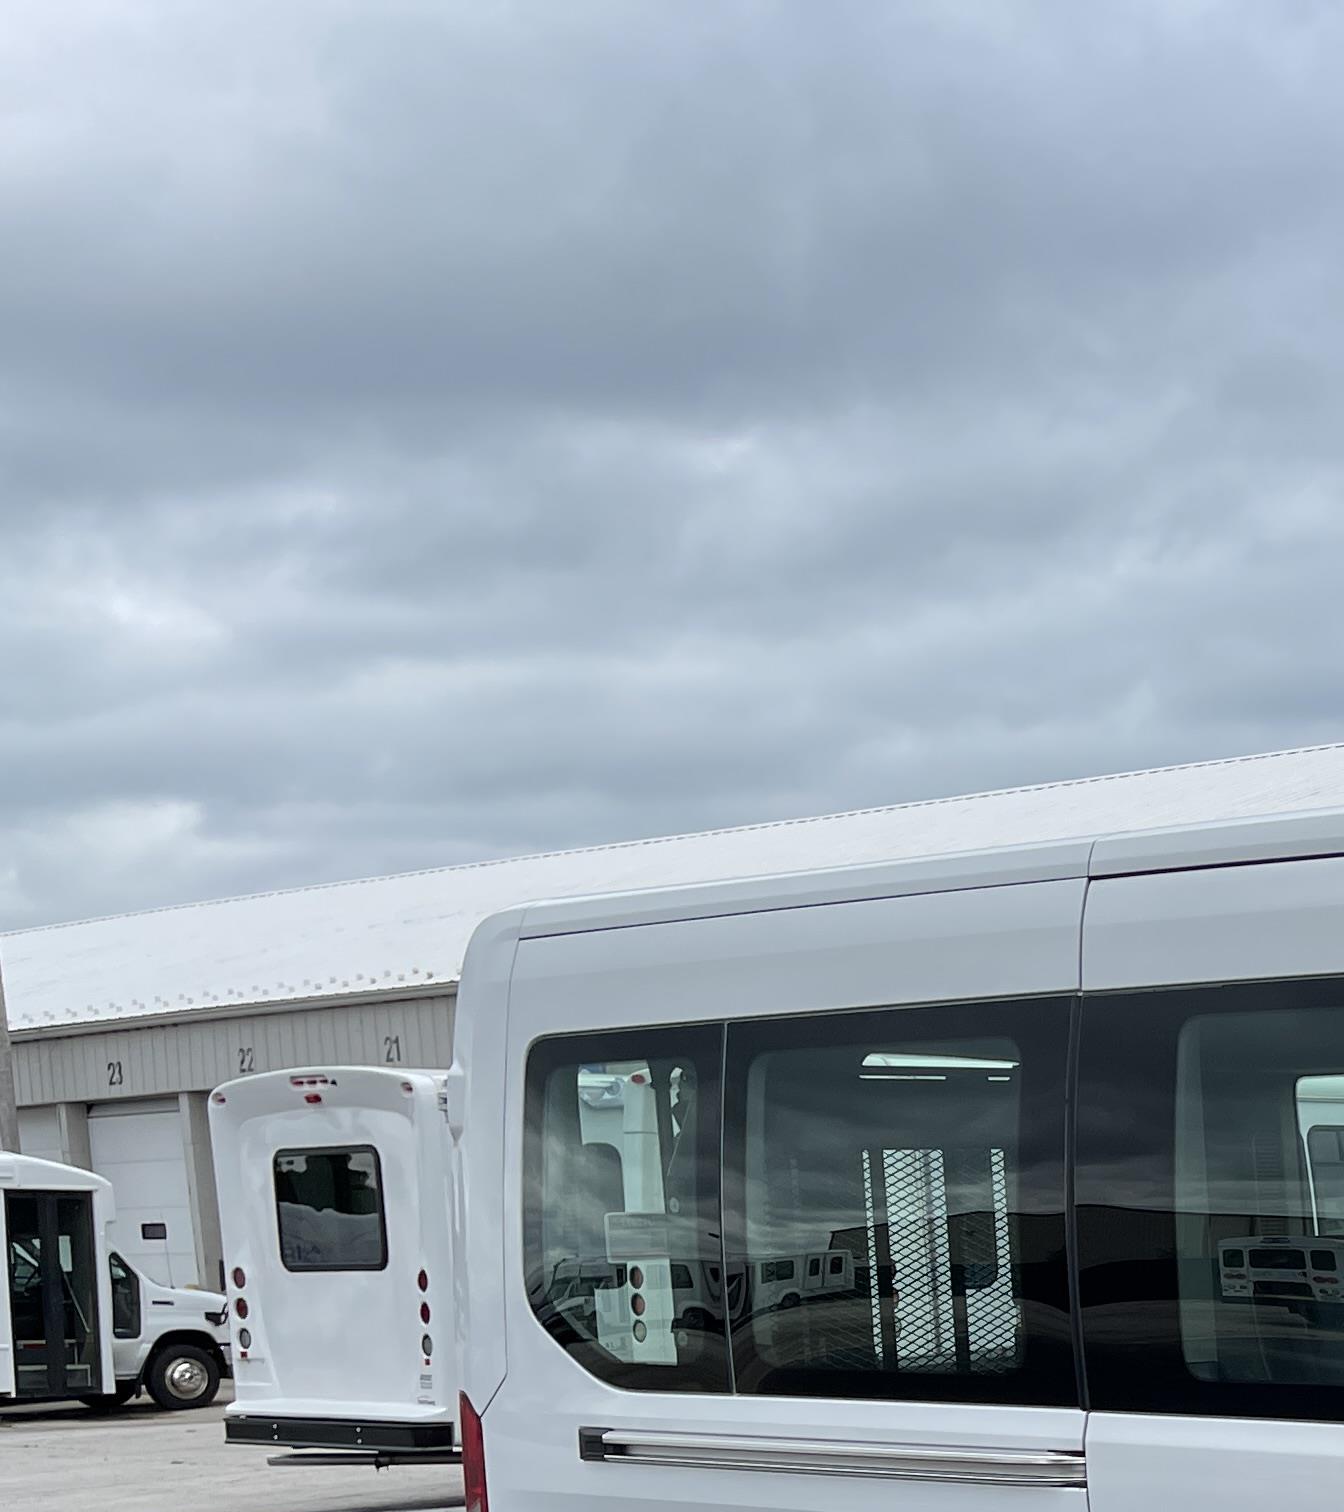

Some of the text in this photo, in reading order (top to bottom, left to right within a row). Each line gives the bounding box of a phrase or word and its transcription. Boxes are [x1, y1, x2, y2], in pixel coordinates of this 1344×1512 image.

[238, 1047, 254, 1073] 22
[384, 1036, 401, 1062] 21
[107, 1061, 123, 1085] 23
